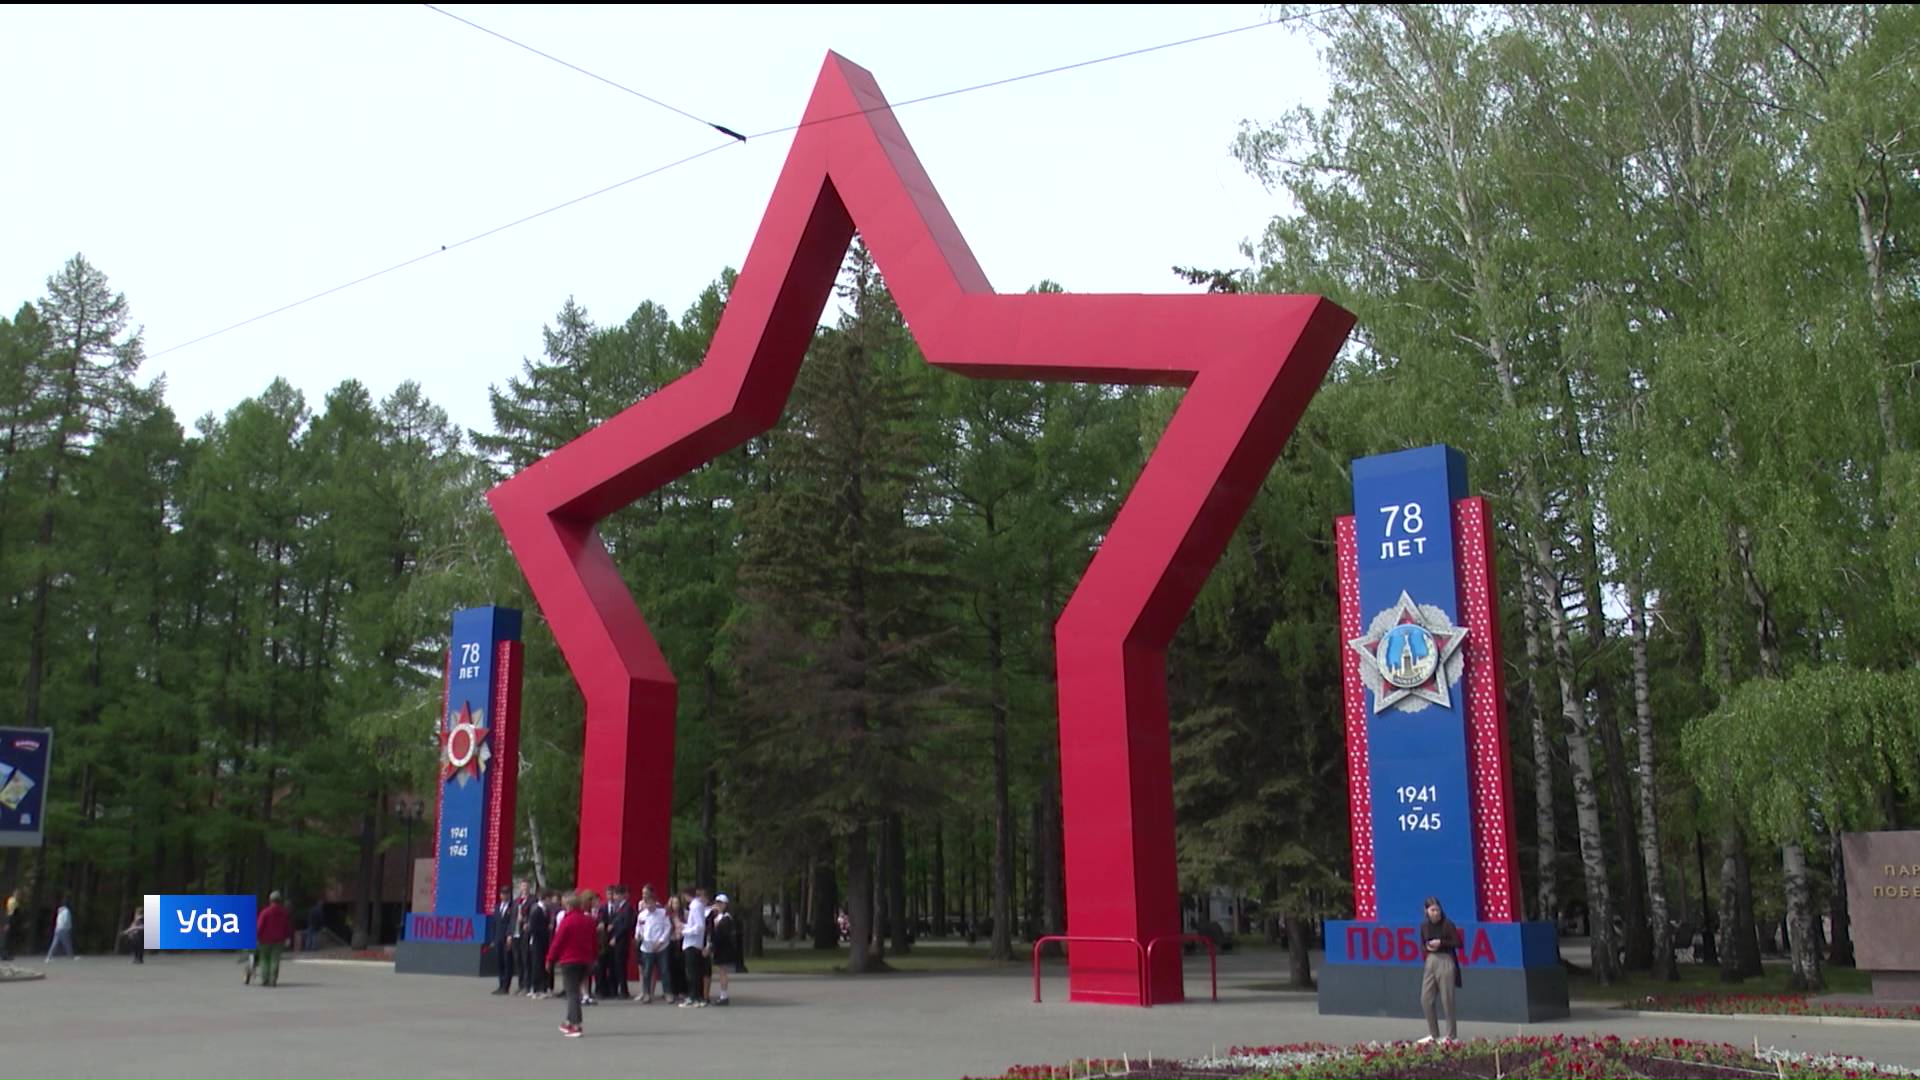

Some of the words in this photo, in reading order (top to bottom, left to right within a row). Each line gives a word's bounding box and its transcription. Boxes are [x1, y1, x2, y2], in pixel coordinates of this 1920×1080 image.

[1380, 503, 1423, 537] 78
[1380, 537, 1427, 559] ЛЕТ
[461, 643, 480, 665] 78
[459, 666, 480, 679] ЛЕТ
[1397, 785, 1436, 803] 1941
[1398, 813, 1441, 831] 1945
[450, 827, 468, 838] 1941
[449, 845, 468, 856] 1945
[414, 915, 475, 941] ПОБЕДА
